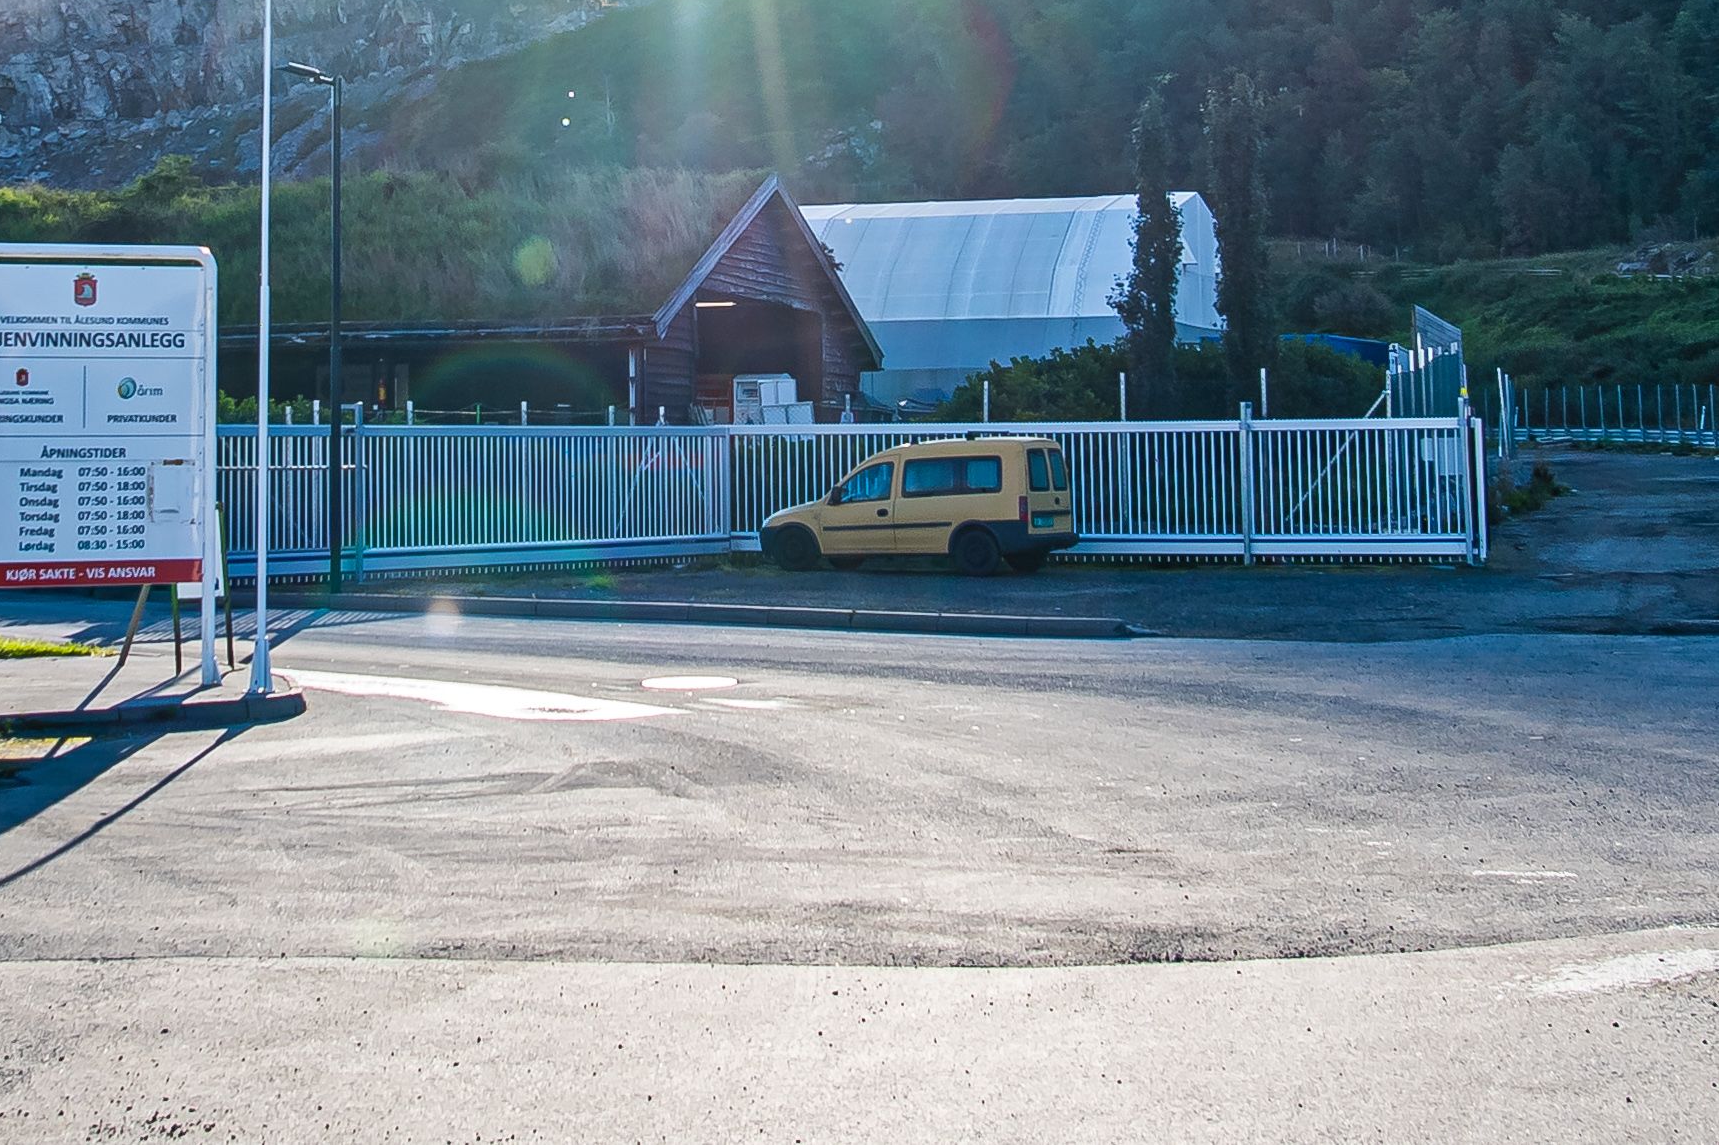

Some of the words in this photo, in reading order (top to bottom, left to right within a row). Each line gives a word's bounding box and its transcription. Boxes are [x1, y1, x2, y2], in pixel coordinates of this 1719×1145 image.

[0, 316, 58, 324] VELKOMMEN
[59, 317, 72, 325] TIL
[74, 315, 115, 325] ÅLESUND
[116, 317, 170, 325] KOMMUNES
[107, 414, 177, 423] PRIVATKUNDER
[40, 446, 126, 458] ÅPNINGSTIDER
[19, 467, 63, 479] Mandag
[77, 467, 108, 477] 07:50
[116, 467, 146, 477] 16:00
[19, 482, 58, 493] Tirsdag
[77, 482, 108, 491] 07:50
[116, 482, 146, 491] 18:00
[19, 496, 59, 508] Onsdag
[77, 496, 108, 506] 07:50
[116, 496, 146, 506] 16:00
[19, 511, 60, 523] Torsdag
[77, 511, 108, 520] 07:50
[116, 511, 146, 520] 18:00
[19, 526, 55, 538] Fredag
[77, 525, 108, 535] 07:50
[116, 525, 146, 535] 16:00
[19, 540, 55, 552] Lørdag
[77, 540, 108, 550] 08:30
[116, 540, 146, 550] 15:00
[6, 569, 37, 581] KJØR
[39, 568, 76, 580] SAKTE
[86, 567, 105, 579] VIS
[107, 567, 156, 578] ANSVAR
